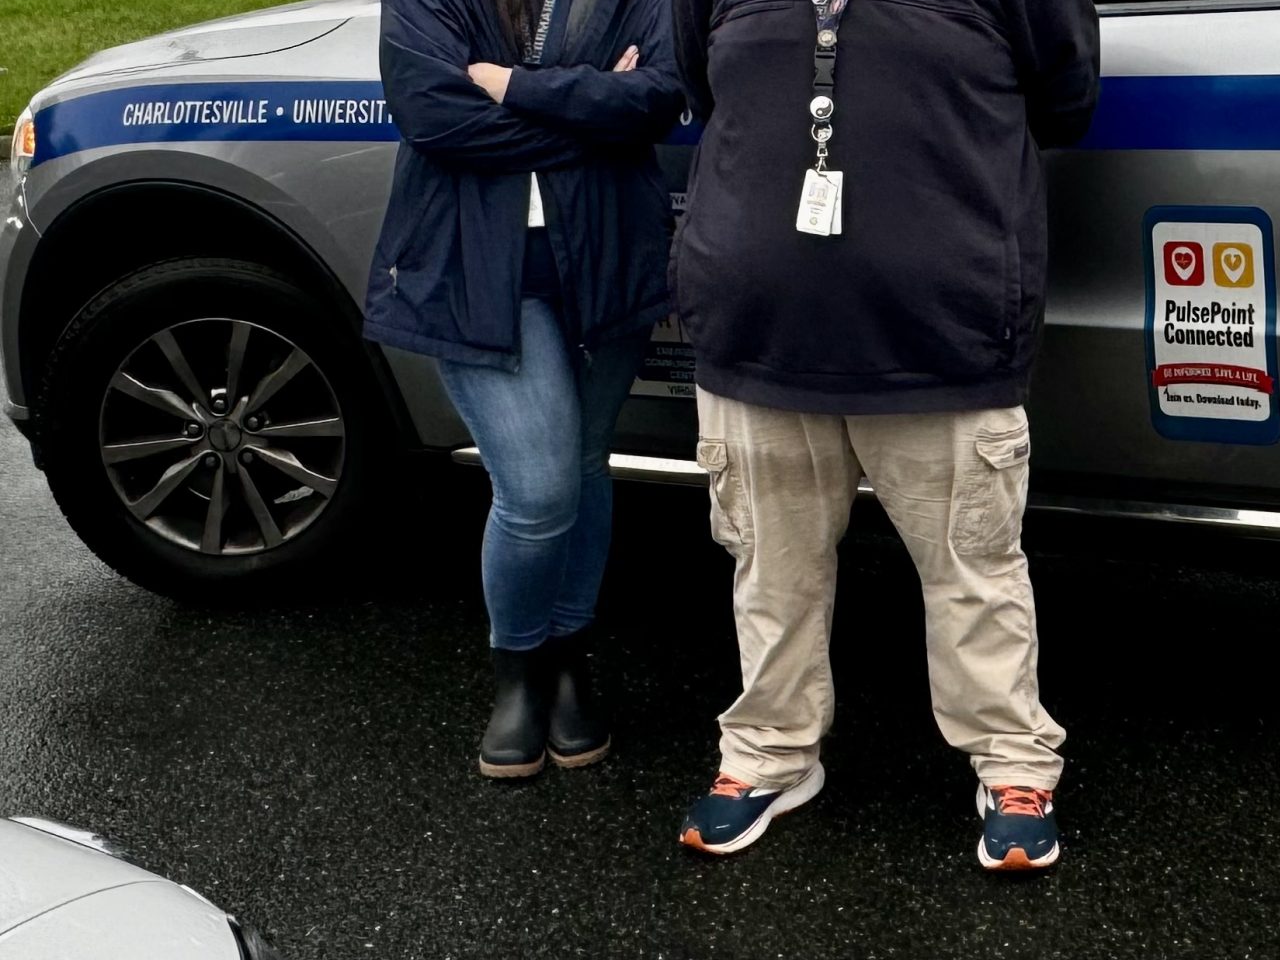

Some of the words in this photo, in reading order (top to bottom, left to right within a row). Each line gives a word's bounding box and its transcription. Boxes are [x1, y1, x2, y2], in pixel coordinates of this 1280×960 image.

[122, 100, 268, 126] CHARLOTTESVILLE
[1165, 299, 1255, 326] PulsePoint
[1164, 323, 1254, 348] Connected
[1196, 393, 1235, 406] Download
